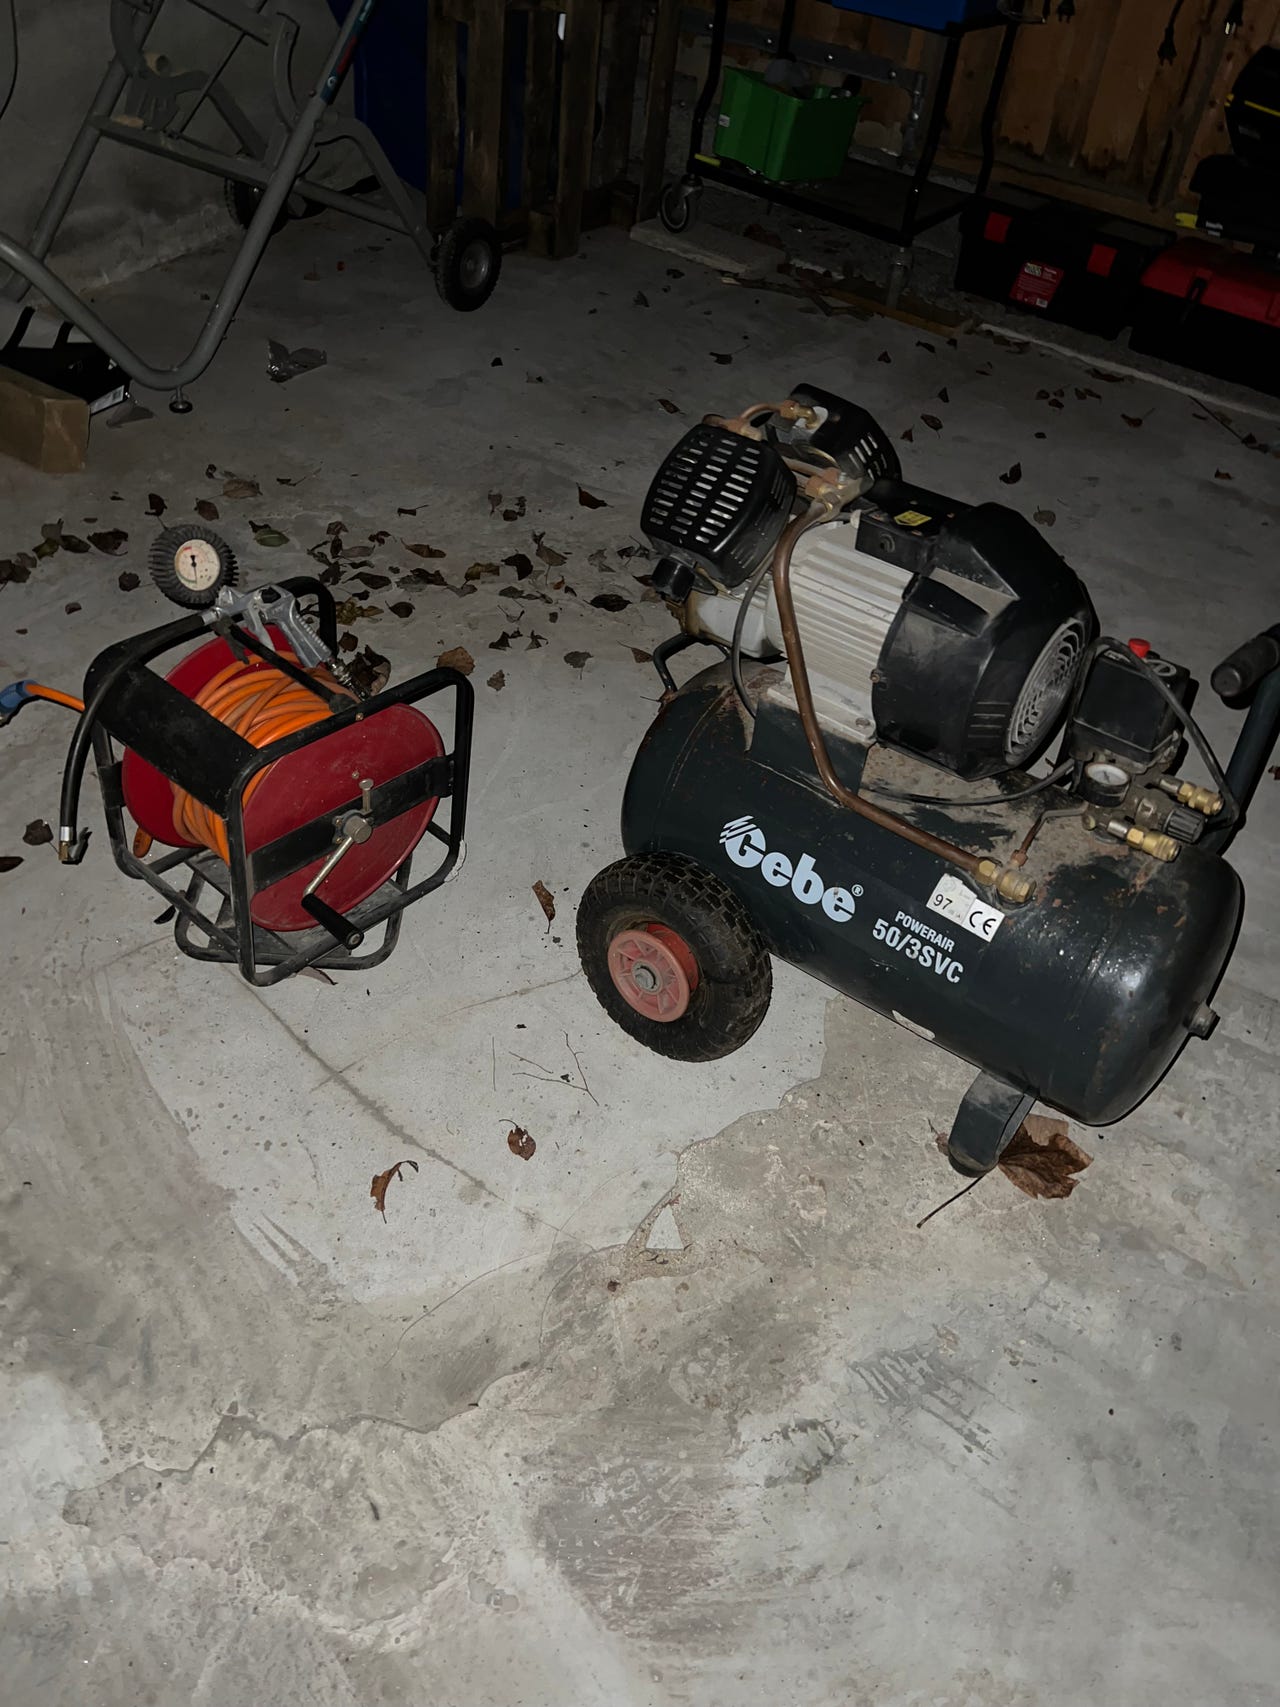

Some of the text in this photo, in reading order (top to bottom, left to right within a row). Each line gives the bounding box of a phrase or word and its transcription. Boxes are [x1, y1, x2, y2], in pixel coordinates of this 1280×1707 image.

[933, 893, 953, 910] 97
[895, 910, 955, 952] POWERAIR
[969, 911, 997, 935] CE
[872, 918, 964, 984] 50/3SVC
